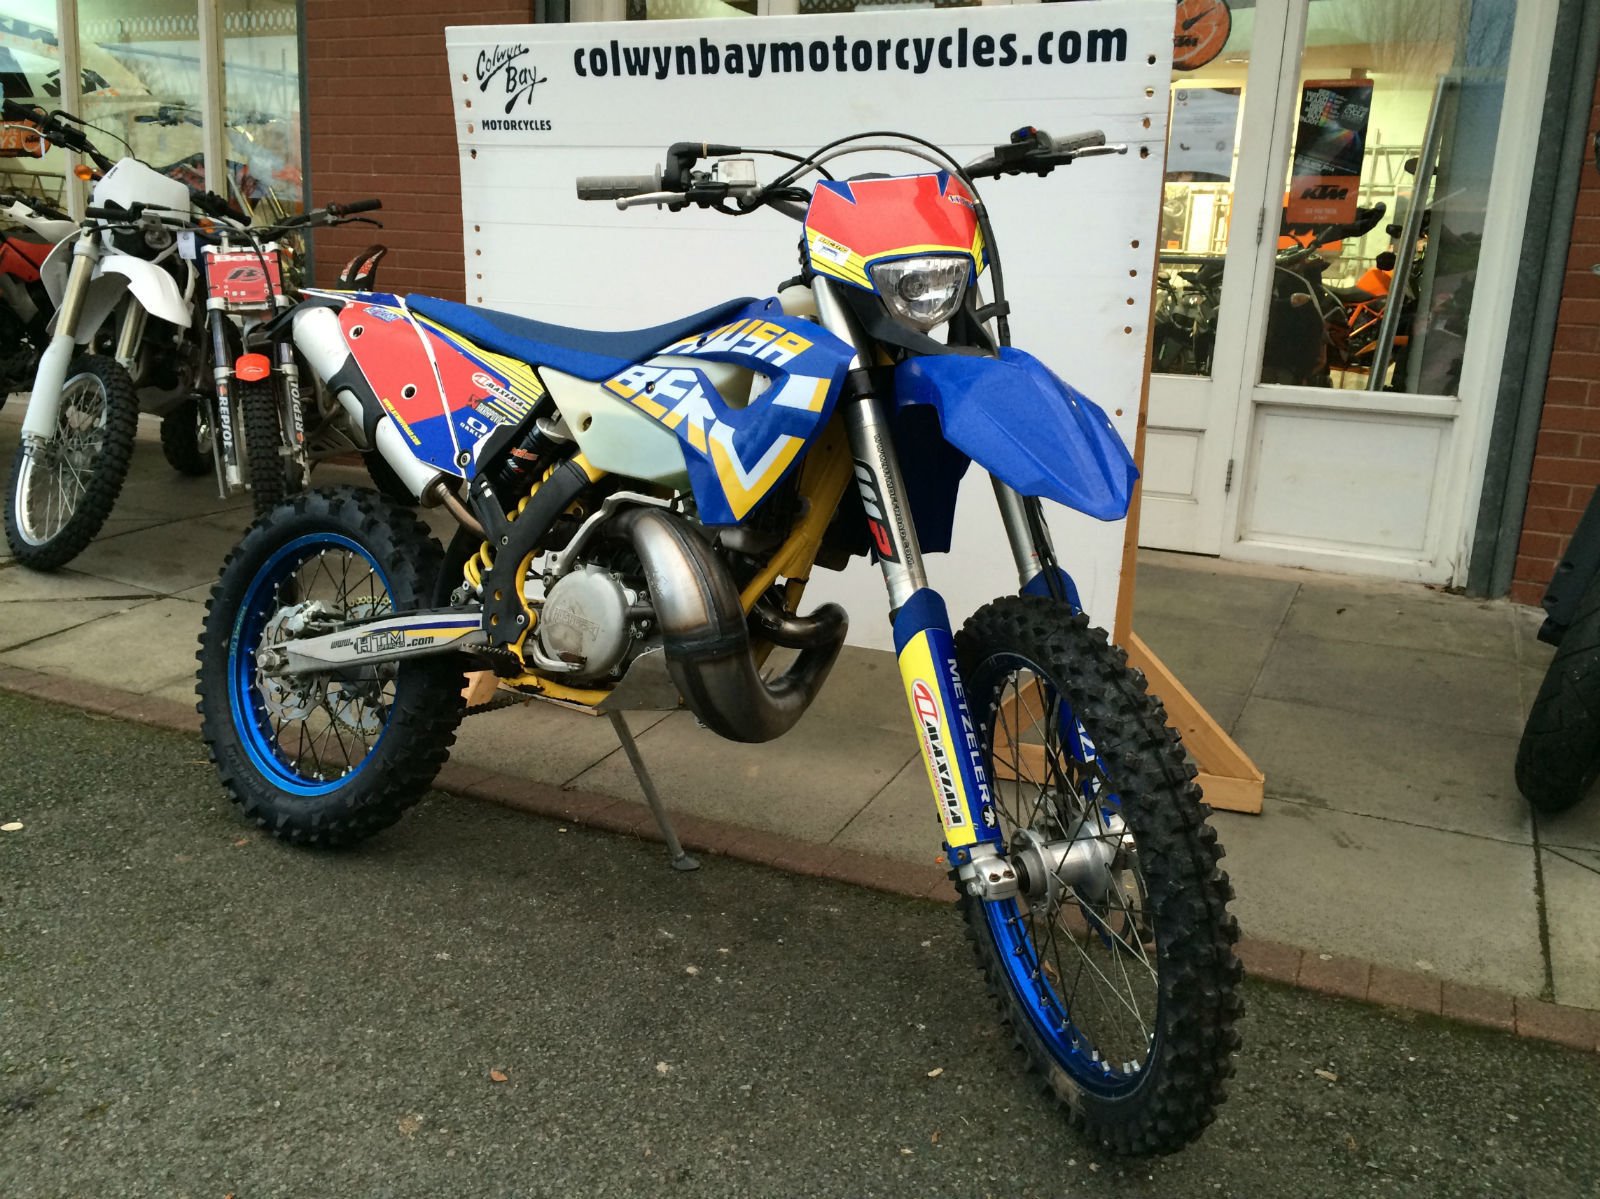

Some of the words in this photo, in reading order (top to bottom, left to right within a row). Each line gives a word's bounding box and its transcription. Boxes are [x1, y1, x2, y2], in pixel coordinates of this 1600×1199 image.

[476, 43, 529, 92] Colwyn
[573, 27, 1128, 80] colwynbaymotorcycles.com
[505, 66, 547, 114] Bay
[482, 119, 552, 131] MOTORCYCLES
[1300, 184, 1349, 201] KTM
[486, 382, 525, 408] MAXIMA
[947, 658, 992, 803] METZELER
[925, 720, 963, 825] MAXIMA
